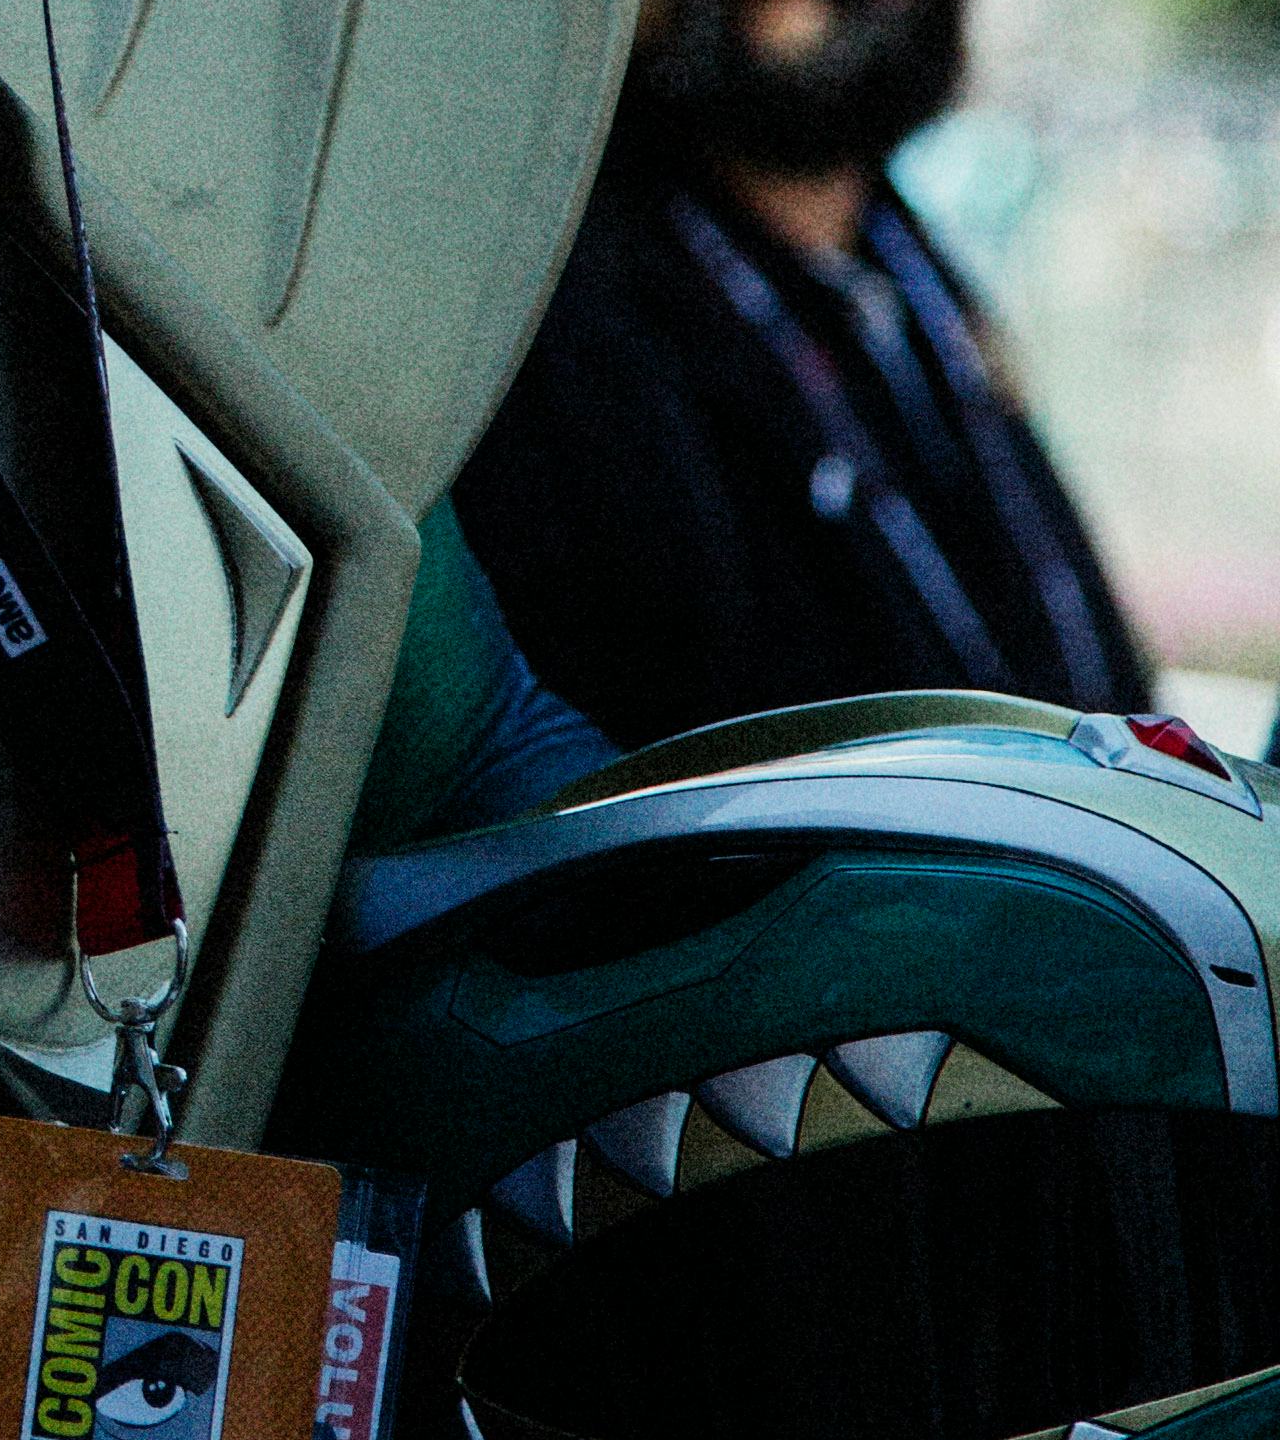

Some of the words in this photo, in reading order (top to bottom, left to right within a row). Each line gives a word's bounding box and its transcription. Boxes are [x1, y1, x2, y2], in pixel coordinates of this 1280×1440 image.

[54, 1218, 112, 1244] SAN
[137, 1231, 234, 1262] DIEGO
[112, 1253, 228, 1329] CON
[36, 1246, 113, 1439] COMIC
